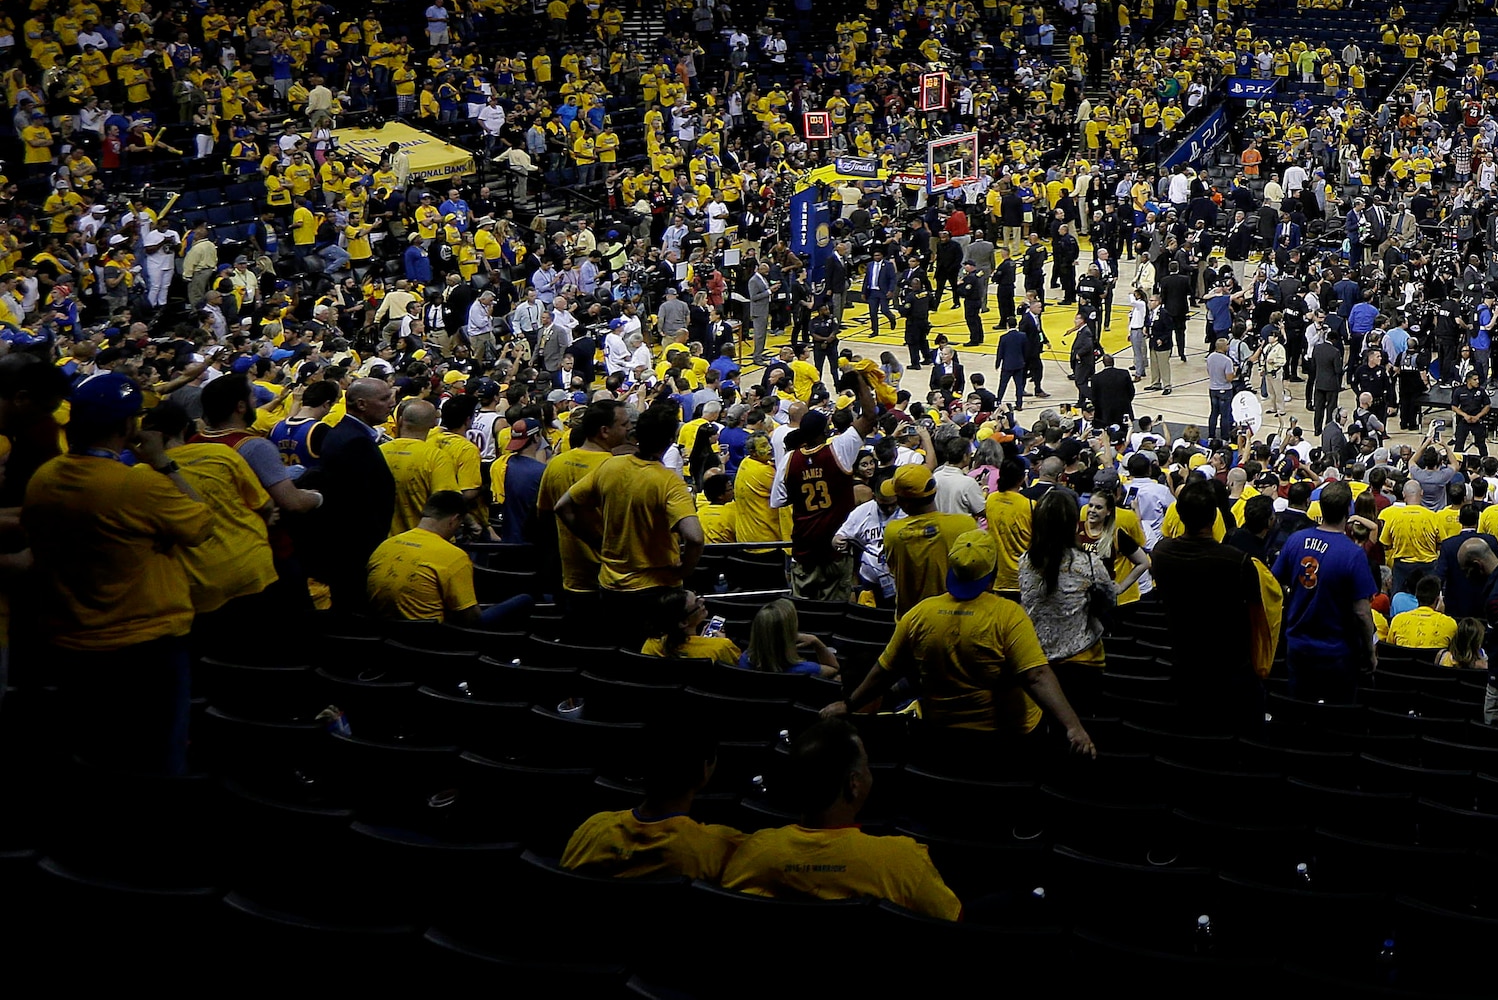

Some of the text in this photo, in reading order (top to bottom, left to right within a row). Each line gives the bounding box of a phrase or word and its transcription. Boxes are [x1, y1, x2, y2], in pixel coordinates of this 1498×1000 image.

[1246, 85, 1273, 94] PS4
[408, 164, 468, 181] ATIONAL BANK
[850, 160, 875, 173] Finals
[802, 468, 823, 480] JAMES
[801, 480, 832, 512] 23
[1304, 537, 1329, 554] EHLO
[1298, 556, 1319, 589] 3
